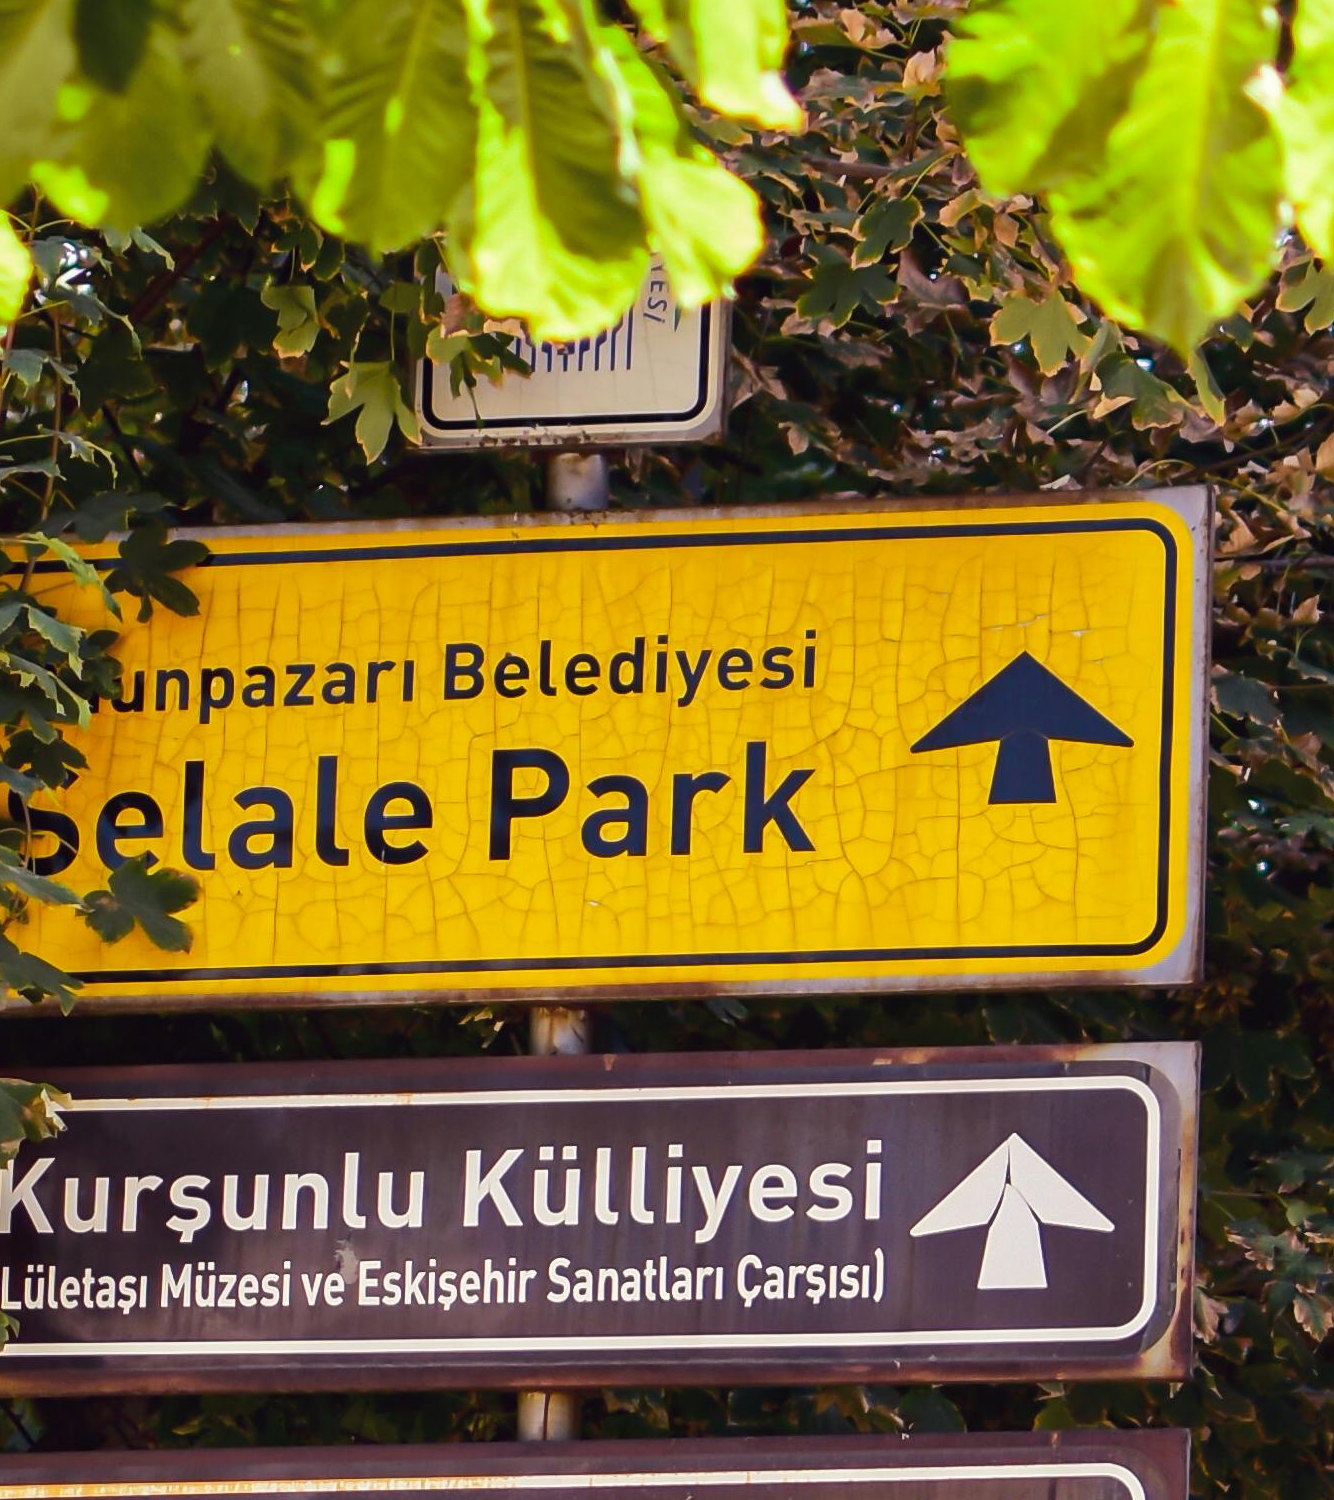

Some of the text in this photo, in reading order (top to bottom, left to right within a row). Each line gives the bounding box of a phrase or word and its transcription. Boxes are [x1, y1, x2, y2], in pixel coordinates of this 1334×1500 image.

[90, 629, 816, 725] unpazarı Belediyesi
[490, 742, 816, 861] Park
[462, 1139, 882, 1244] Külliyesi
[160, 1260, 291, 1308] Müzesi
[300, 1272, 347, 1307] ve
[357, 1259, 535, 1312] Eskişehir
[546, 1255, 724, 1304] Sanatları
[736, 1247, 885, 1308] Çarşısı)
